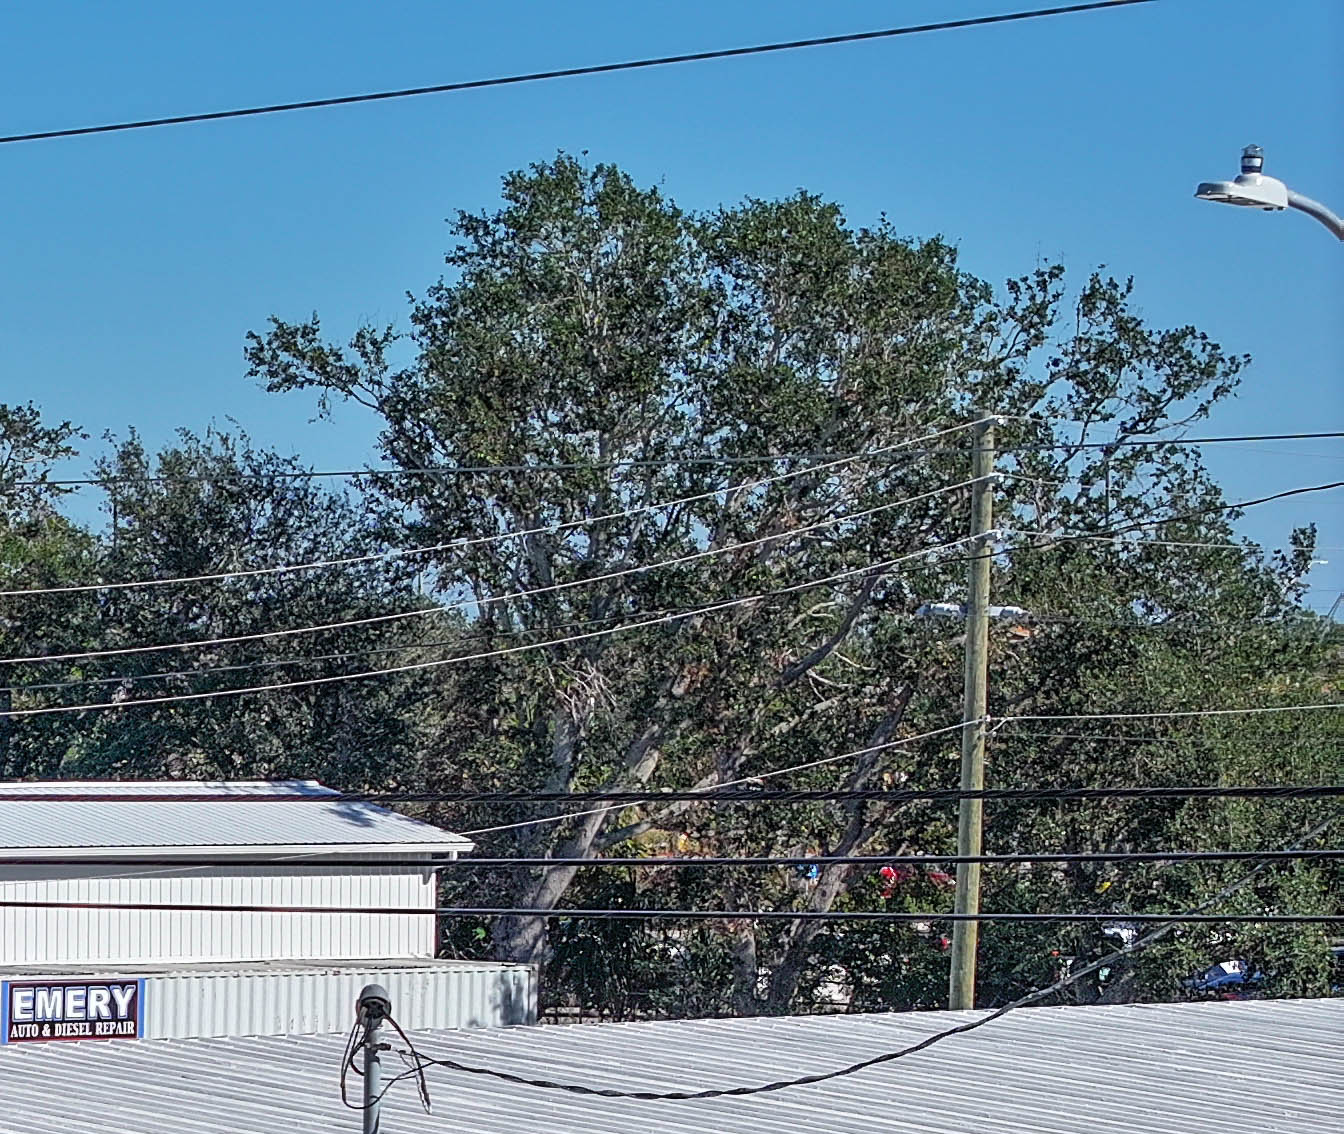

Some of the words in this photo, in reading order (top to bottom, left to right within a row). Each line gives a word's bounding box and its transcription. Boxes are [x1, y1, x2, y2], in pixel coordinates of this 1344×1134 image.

[12, 984, 137, 1022] EMERY
[10, 1024, 39, 1038] AUTO
[42, 1023, 51, 1037] &
[54, 1022, 92, 1037] DIESEL
[95, 1021, 135, 1035] REPAIR
